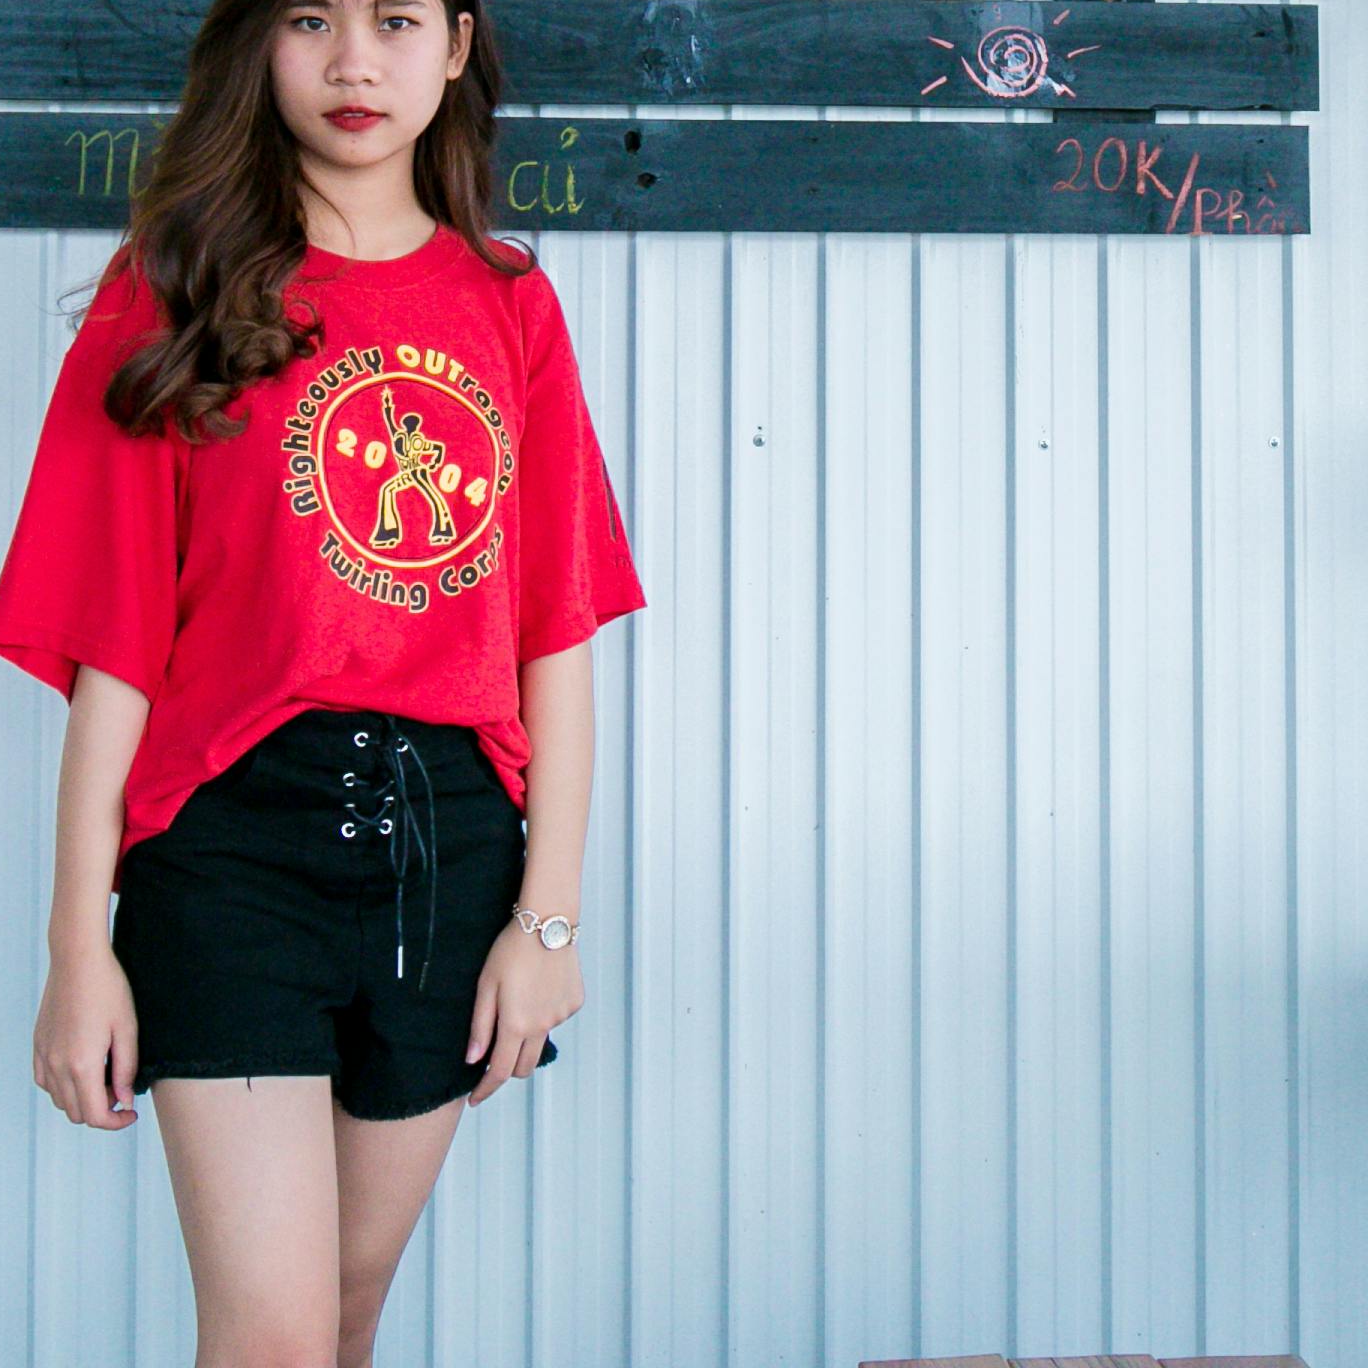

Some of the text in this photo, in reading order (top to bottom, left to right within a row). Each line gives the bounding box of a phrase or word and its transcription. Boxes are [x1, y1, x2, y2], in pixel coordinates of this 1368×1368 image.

[280, 343, 514, 517] Righteously OUTrageou
[319, 528, 431, 614] Twirling
